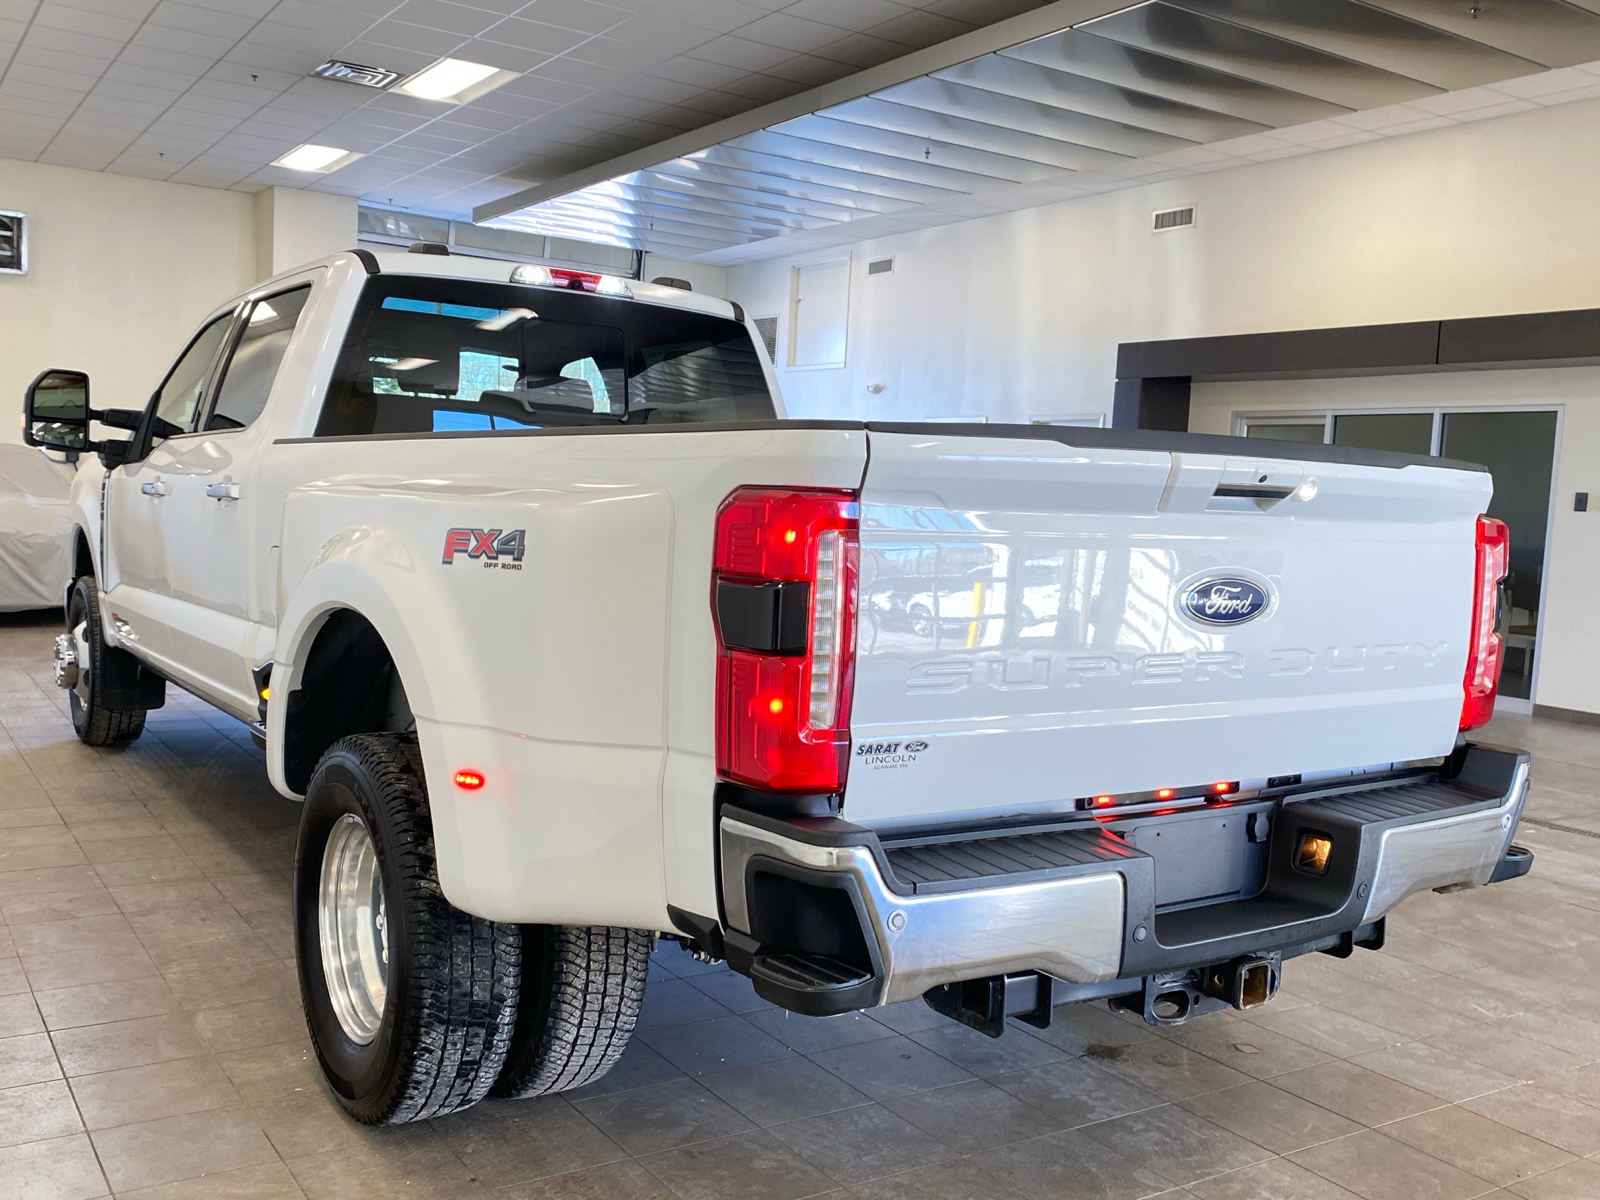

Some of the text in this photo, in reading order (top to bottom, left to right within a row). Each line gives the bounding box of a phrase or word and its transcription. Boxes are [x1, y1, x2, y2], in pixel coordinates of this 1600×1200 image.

[442, 528, 526, 565] FX4
[501, 562, 522, 570] ROAD
[1205, 585, 1253, 615] Ford
[906, 640, 1448, 696] SUPER DUTY
[855, 741, 928, 756] SARAT Ford
[865, 754, 917, 765] LINCOLN
